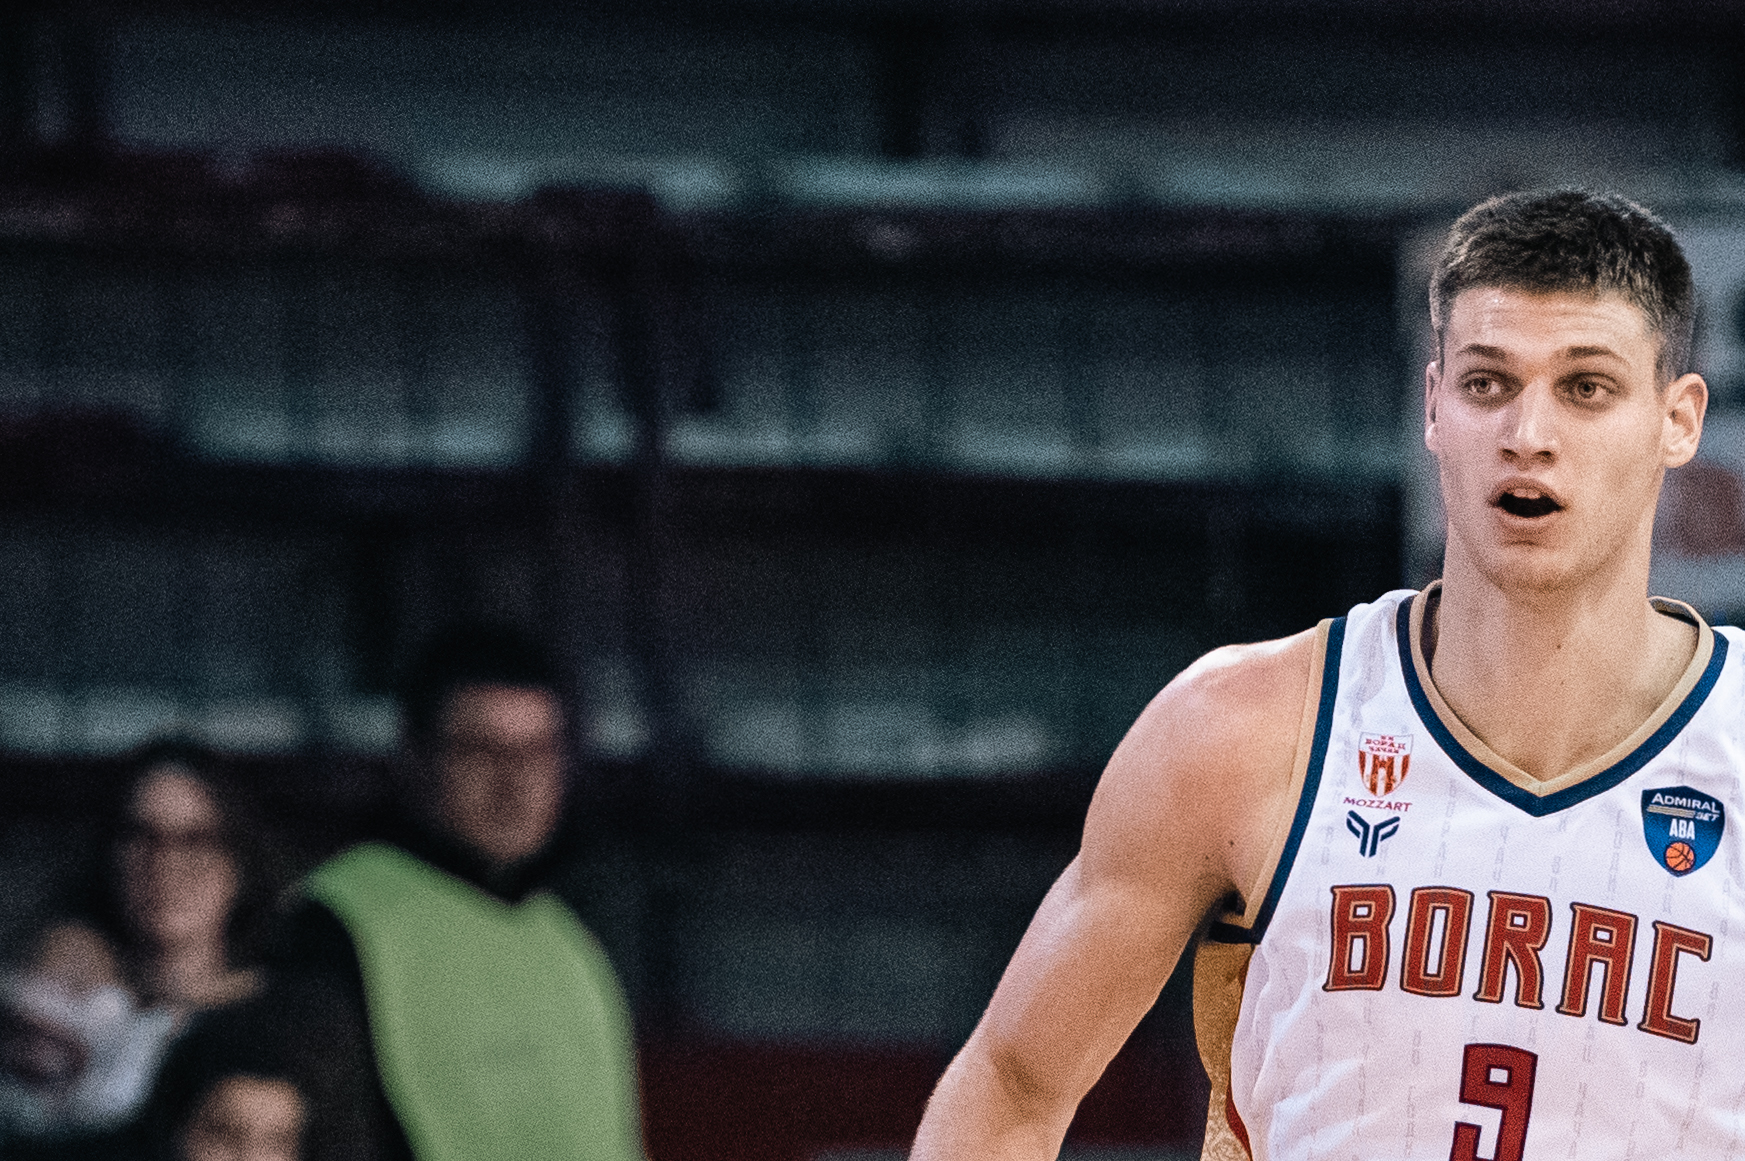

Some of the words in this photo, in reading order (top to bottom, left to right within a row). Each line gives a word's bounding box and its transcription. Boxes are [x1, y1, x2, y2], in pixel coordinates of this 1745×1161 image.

[1343, 797, 1413, 812] MOZZART
[1651, 792, 1721, 815] ADMIRAL
[1668, 818, 1695, 840] ABA
[1323, 883, 1713, 1044] BORAC
